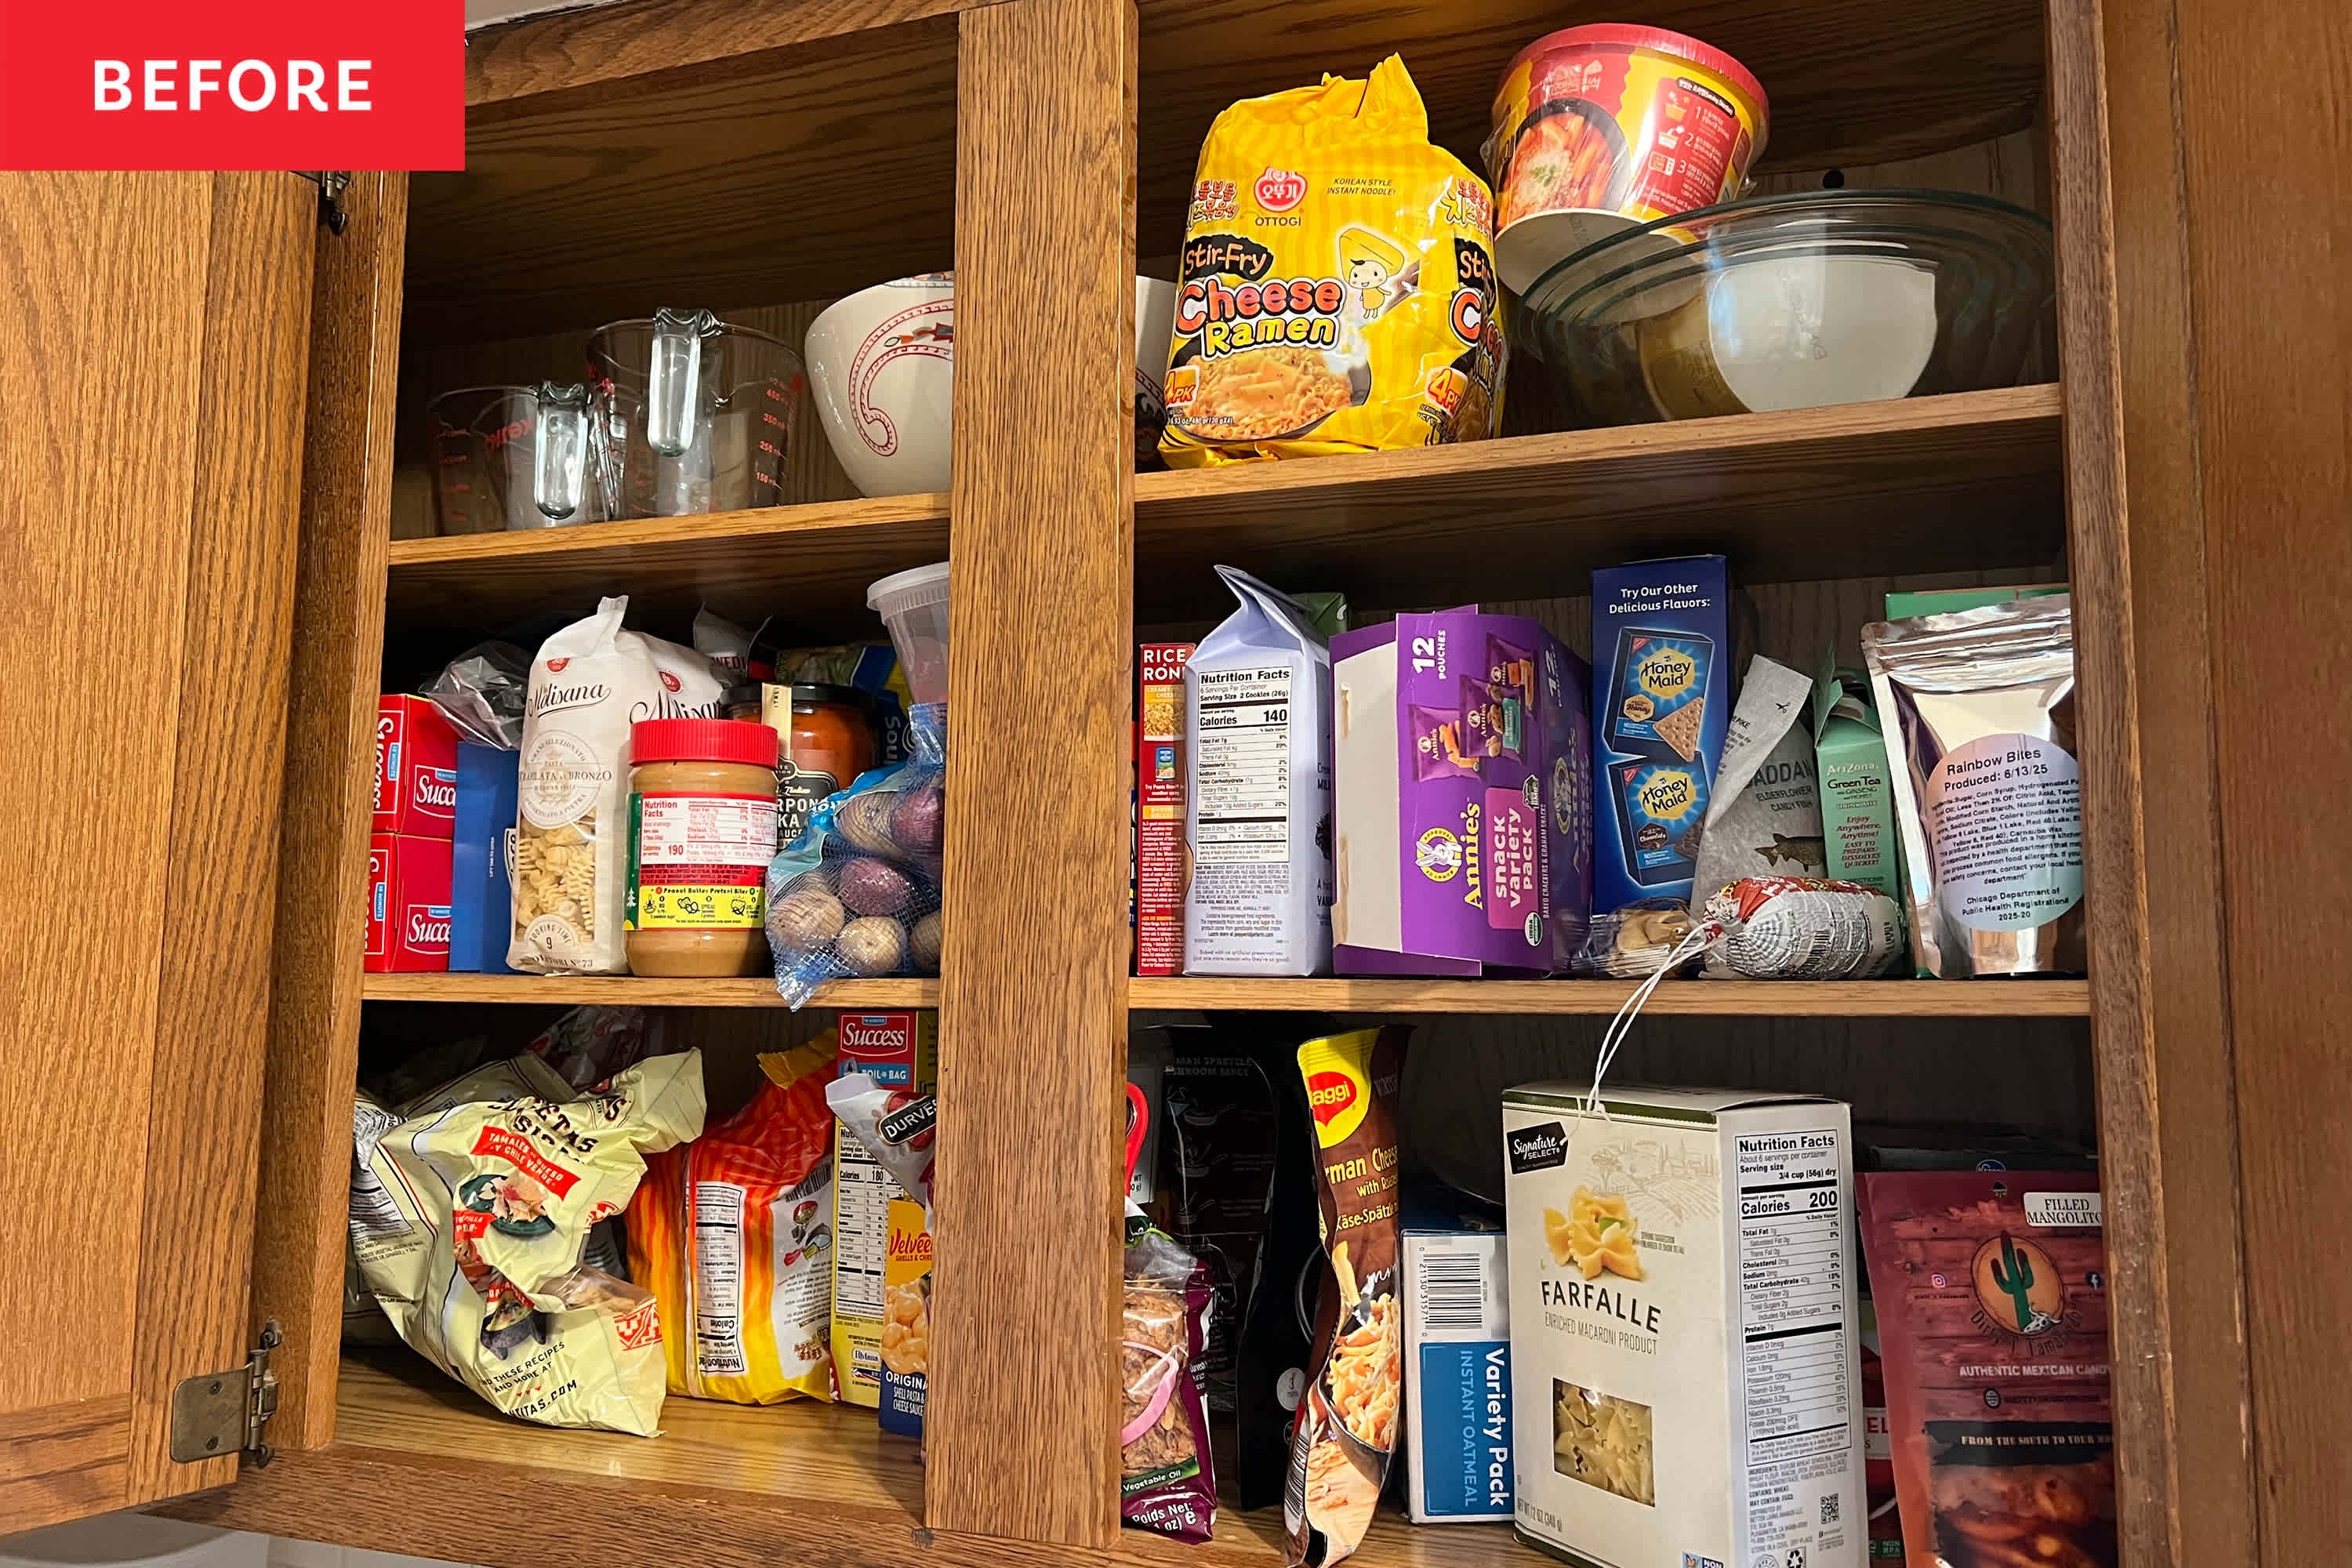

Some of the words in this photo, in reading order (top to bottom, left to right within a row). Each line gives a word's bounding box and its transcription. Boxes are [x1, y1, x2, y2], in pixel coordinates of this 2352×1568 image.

[1685, 132, 1694, 146] 2
[1677, 160, 1686, 173] 3
[1262, 184, 1298, 200] 오뚜기
[1255, 217, 1301, 227] OTTOGI
[1185, 243, 1267, 275] Stir-Fry
[1176, 279, 1343, 333] Cheese
[1205, 317, 1335, 357] Ramen
[1621, 589, 1639, 599] Try
[1640, 586, 1662, 597] Our
[1664, 583, 1698, 595] Other
[1610, 601, 1661, 614] Delicious
[1663, 597, 1711, 610] Flavors:
[1144, 649, 1185, 663] RICE
[1412, 637, 1435, 674] 12
[1436, 630, 1446, 679] POUCHES
[1201, 672, 1252, 684] Nutrition
[1258, 670, 1290, 681] Facts
[1641, 661, 1692, 681] Honey
[1649, 673, 1685, 688] Maid
[1200, 716, 1237, 727] Calories
[1263, 710, 1287, 722] 140
[1947, 755, 2002, 775] Rainbow
[2006, 750, 2042, 763] Bites
[568, 769, 612, 781] BRONZO
[1754, 759, 1813, 786] ADDAN
[1944, 772, 2001, 792] Produced:
[2004, 764, 2048, 779] 6/13/25
[1828, 779, 1860, 789] Green
[1861, 776, 1882, 786] Tea
[1994, 786, 2016, 796] Syrup,
[2018, 779, 2069, 791] Hydrogenated
[1642, 777, 1689, 810] Honey
[1756, 785, 1813, 801] ELDERFLOWER
[644, 800, 677, 809] Nutrition
[1651, 790, 1688, 814] Maid
[644, 809, 664, 818] Facts
[1846, 815, 1870, 824] Enjoy
[1841, 831, 1879, 840] Anytime!
[1986, 837, 2018, 848] produced
[668, 844, 684, 855] 190
[1461, 801, 1483, 910] Annie's
[2010, 844, 2053, 853] department
[2000, 864, 2027, 873] contact
[1966, 894, 1998, 905] Chicago
[2000, 888, 2049, 900] Department
[1962, 906, 1984, 916] Public
[1985, 902, 2012, 911] Health
[1998, 911, 2031, 921] 2025-20
[546, 937, 553, 949] 9
[843, 1022, 905, 1047] Success
[889, 1070, 906, 1080] BAG
[489, 1133, 528, 1153] TAMALES
[1513, 1134, 1558, 1160] Signature
[1739, 1138, 1797, 1152] Nutrition
[1801, 1135, 1835, 1148] Facts
[504, 1146, 523, 1165] CHILE
[1528, 1149, 1555, 1160] SELECT
[1740, 1155, 1757, 1163] About
[1764, 1153, 1789, 1163] servings
[840, 1171, 859, 1180] Calories
[872, 1170, 884, 1181] 180
[1740, 1164, 1768, 1174] Serving
[1770, 1163, 1784, 1171] size
[1806, 1169, 1824, 1178] (56g)
[1825, 1167, 1836, 1177] dry
[1356, 1178, 1380, 1198] with
[1741, 1201, 1791, 1214] Calories
[1809, 1190, 1838, 1208] 200
[2045, 1199, 2089, 1210] FILLED
[889, 1228, 933, 1257] Velvee
[1743, 1260, 1777, 1269] Cholesterol
[1759, 1279, 1799, 1289] Carbohydrate
[1541, 1280, 1661, 1334] FARFALLE
[1544, 1312, 1575, 1334] ENRICHED
[1577, 1321, 1617, 1346] MACARONI
[1619, 1331, 1657, 1355] PRODUCT
[1744, 1325, 1766, 1334] Protein
[494, 1365, 524, 1383] THESE
[524, 1341, 564, 1369] RECIPES
[495, 1382, 513, 1393] AND
[514, 1370, 539, 1385] MORE
[542, 1361, 552, 1373] AT
[1960, 1365, 2020, 1377] AUTHENTIC
[2023, 1365, 2074, 1376] MEXICAN
[1461, 1350, 1476, 1422] INSTANT
[894, 1386, 906, 1400] SHELL
[907, 1388, 920, 1403] PASTA
[1483, 1348, 1507, 1441] Variety
[893, 1399, 909, 1414] CHEESE
[909, 1402, 924, 1416] SAUCE
[1962, 1436, 1994, 1446] FROM
[1997, 1436, 2015, 1445] THE
[2053, 1436, 2065, 1444] TO
[1462, 1425, 1478, 1507] OATMEAL
[1123, 1474, 1166, 1491] Vegetable
[1168, 1469, 1181, 1479] Oil
[1489, 1447, 1510, 1507] Pack
[1164, 1516, 1182, 1530] oz)
[1185, 1510, 1196, 1525] e
